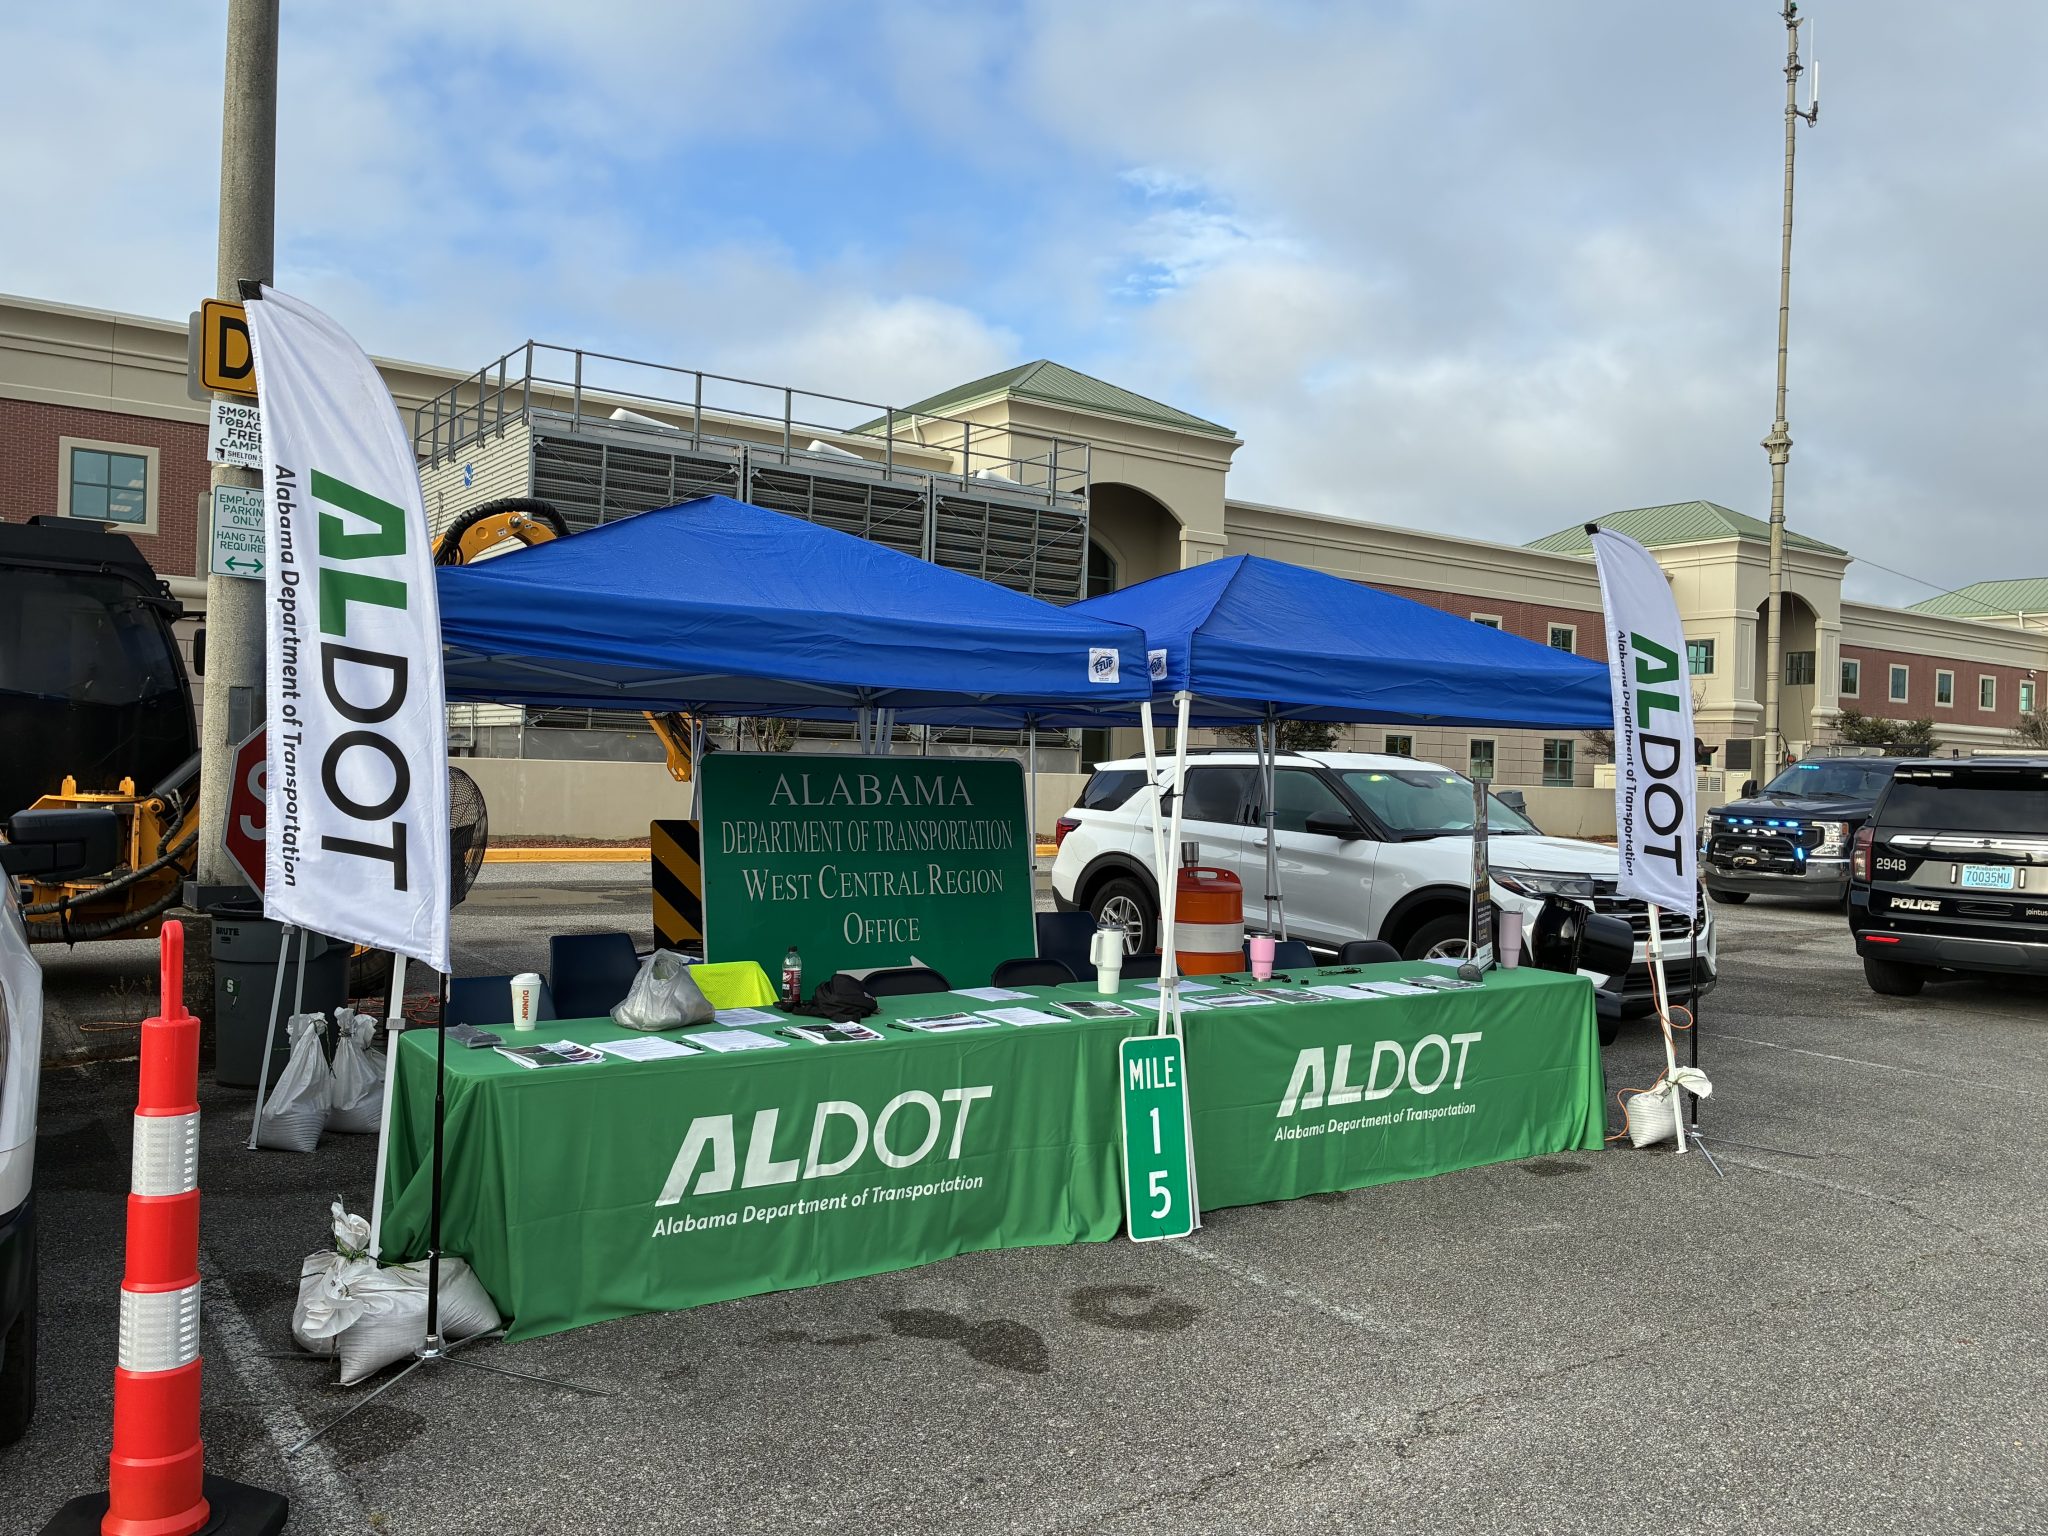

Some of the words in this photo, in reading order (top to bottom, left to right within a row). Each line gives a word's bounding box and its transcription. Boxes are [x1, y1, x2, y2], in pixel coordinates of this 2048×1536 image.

[217, 415, 262, 431] TOBAC
[219, 438, 263, 453] CAMP
[227, 450, 258, 461] SHELTON
[219, 493, 265, 508] EMPLOY
[223, 504, 264, 517] PARKIN
[275, 464, 298, 564] Alabama
[216, 530, 246, 542] HANG
[232, 515, 262, 527] ONLY
[220, 541, 266, 554] REQUIRE
[276, 570, 303, 699] Department
[1617, 630, 1628, 688] Alabama
[310, 468, 411, 892] ALDOT
[282, 704, 303, 728] of
[1623, 690, 1634, 766] Department
[1630, 631, 1684, 877] ALDOT
[769, 773, 974, 806] ALABAMA
[1626, 767, 1637, 784] of
[282, 732, 302, 887] Transportation
[721, 820, 843, 854] DEPARTMENT
[847, 820, 869, 852] OF
[873, 819, 1013, 851] TRANSPORTATION
[1623, 785, 1636, 876] Transportation
[1876, 857, 1907, 871] 2948
[1966, 871, 2010, 884] 70035MU
[741, 869, 812, 901] WEST
[818, 864, 925, 899] CENTRAL
[927, 863, 1004, 895] REGION
[1890, 897, 1941, 911] POLICE
[216, 926, 240, 936] BRUTE
[843, 912, 921, 944] OFFICE
[1129, 1056, 1177, 1090] MILE
[1276, 1031, 1483, 1118] ALDOT
[1149, 1107, 1162, 1154] 1
[1274, 1123, 1325, 1141] Alabama
[1327, 1113, 1392, 1134] Department
[1393, 1108, 1406, 1123] of
[1406, 1103, 1476, 1122] Transportation
[654, 1085, 993, 1207] ALDOT
[652, 1211, 738, 1238] Alabama
[743, 1195, 848, 1224] Department
[851, 1188, 870, 1207] of
[872, 1175, 984, 1204] Transportation
[1149, 1169, 1172, 1219] 5
